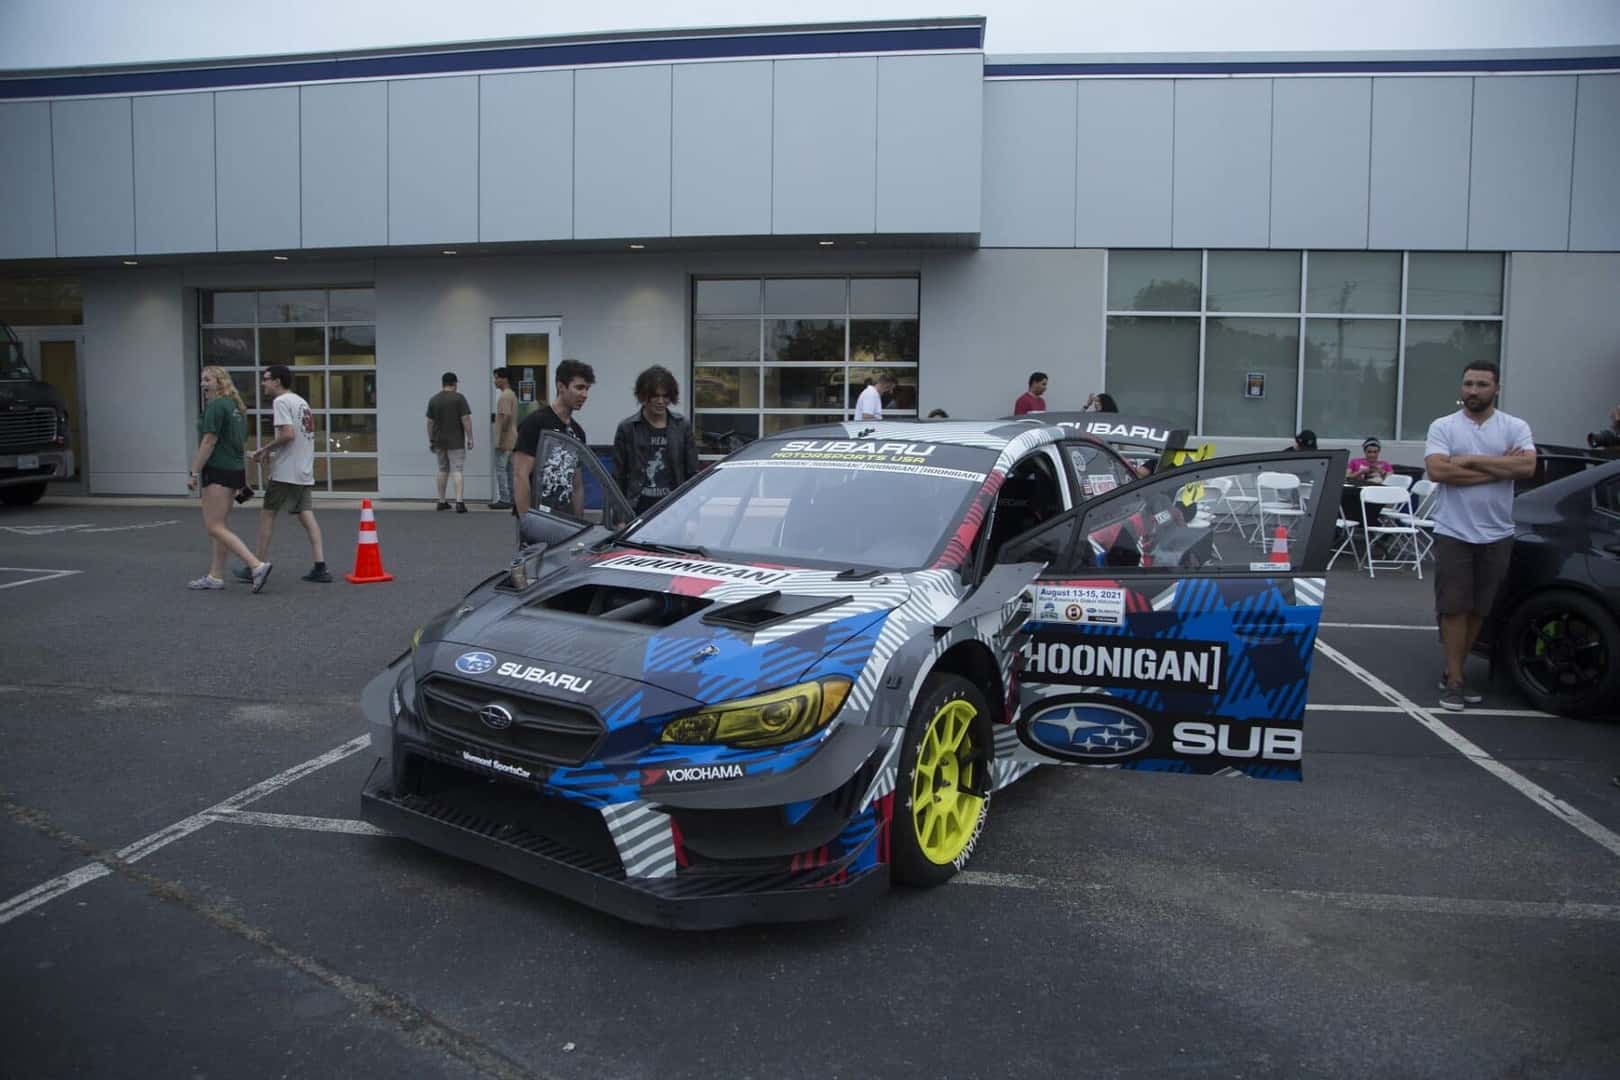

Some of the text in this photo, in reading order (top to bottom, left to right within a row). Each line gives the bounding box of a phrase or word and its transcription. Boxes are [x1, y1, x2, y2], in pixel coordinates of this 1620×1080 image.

[781, 440, 936, 456] SUBARU
[771, 452, 926, 464] MOTORSPORTS USA
[602, 555, 791, 585] [HOONIGAN]
[1041, 588, 1121, 600] August 13-15, 2021
[497, 662, 592, 693] SUBARU
[1172, 721, 1303, 761] SUB
[493, 759, 531, 777] SportsCar
[666, 764, 743, 782] YOKOHAMA
